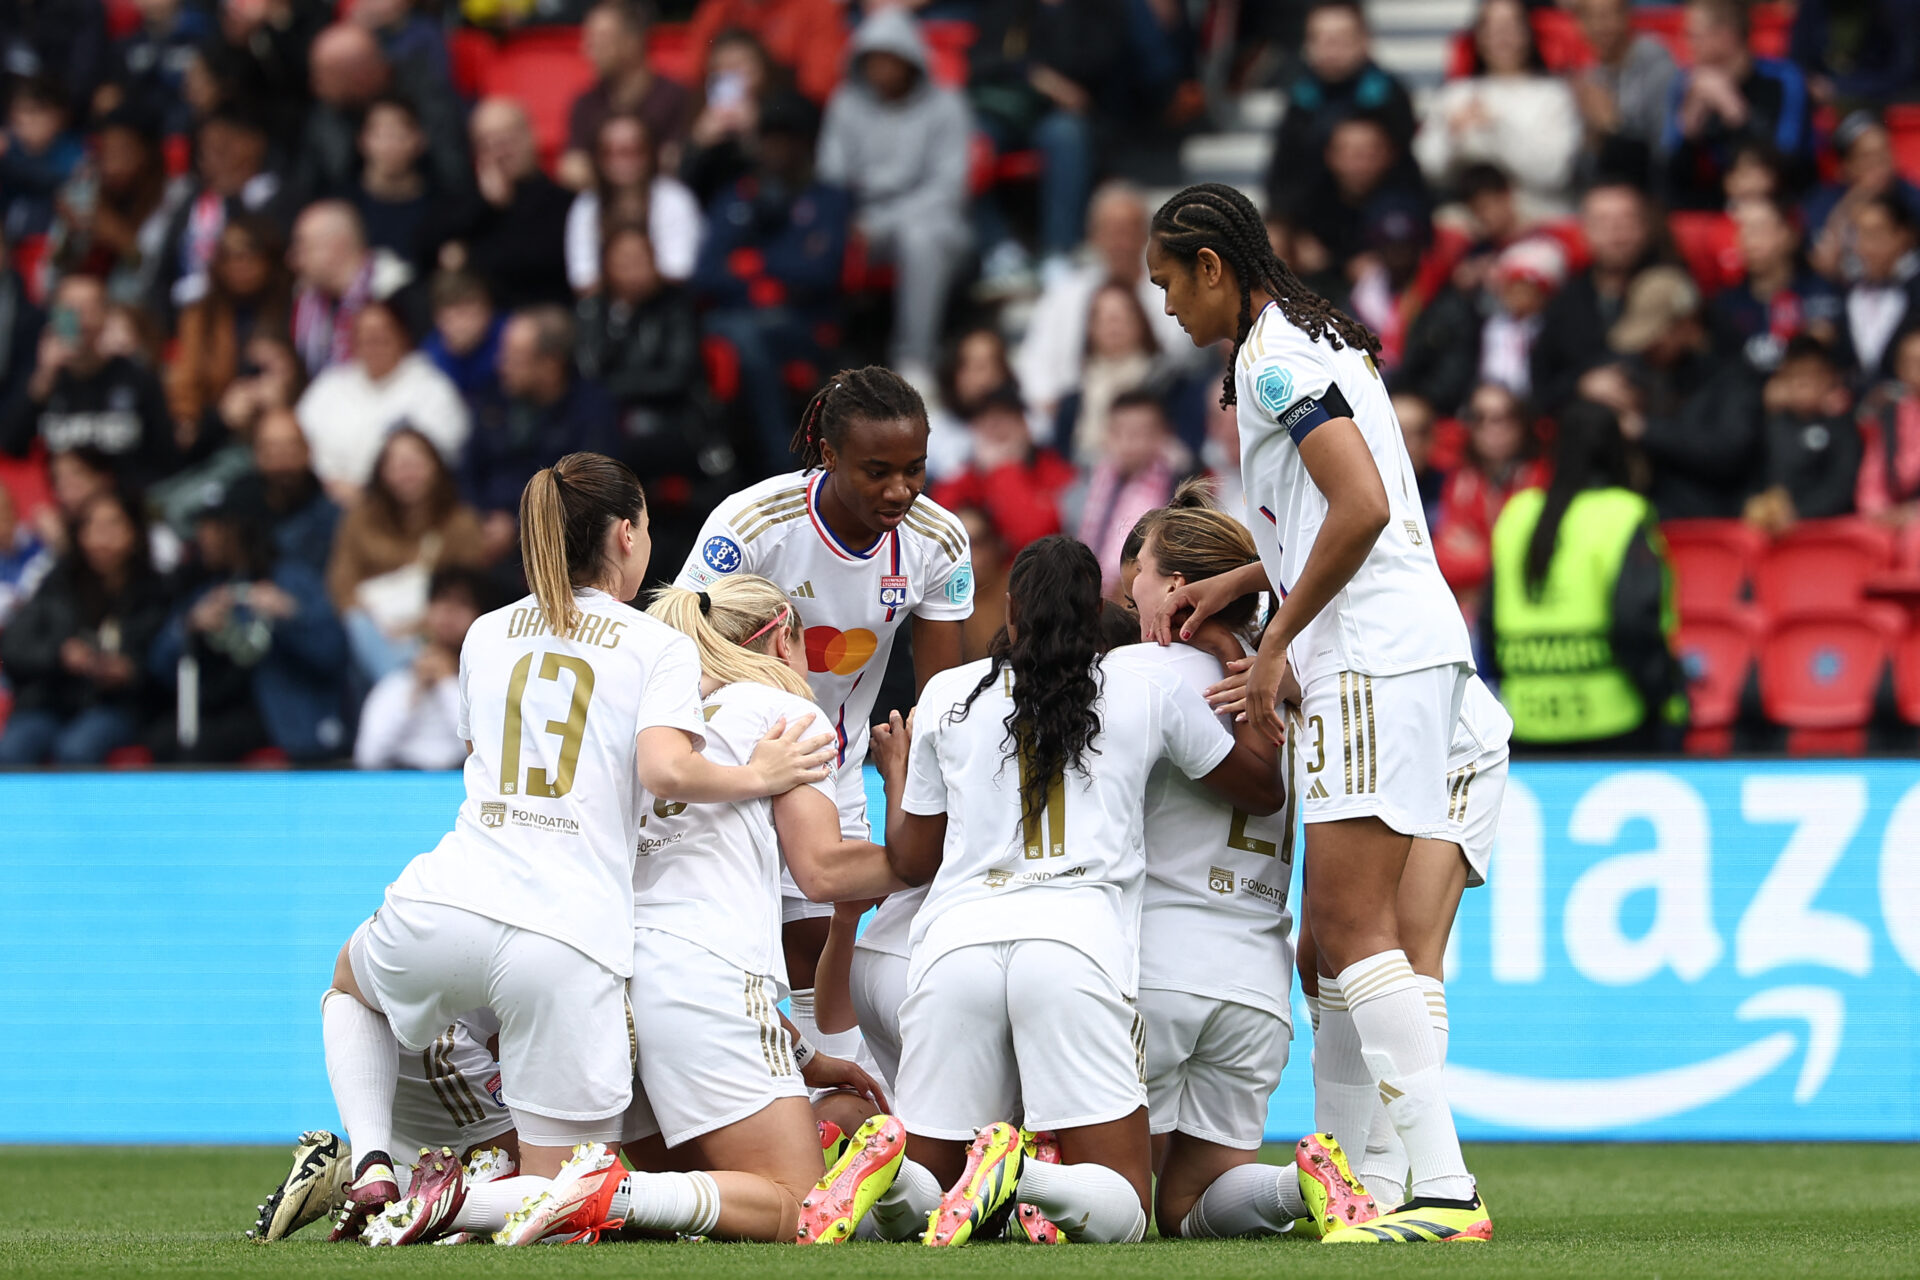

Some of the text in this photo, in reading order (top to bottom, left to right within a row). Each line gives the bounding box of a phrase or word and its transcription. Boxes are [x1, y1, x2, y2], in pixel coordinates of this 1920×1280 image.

[1285, 400, 1315, 427] RESPECT
[716, 547, 729, 560] 8
[881, 588, 905, 604] OL
[507, 606, 629, 649] DARIS
[499, 650, 596, 799] 13
[1306, 714, 1326, 774] 3
[511, 809, 580, 830] FONDATION
[1240, 878, 1287, 903] FONDATIO
